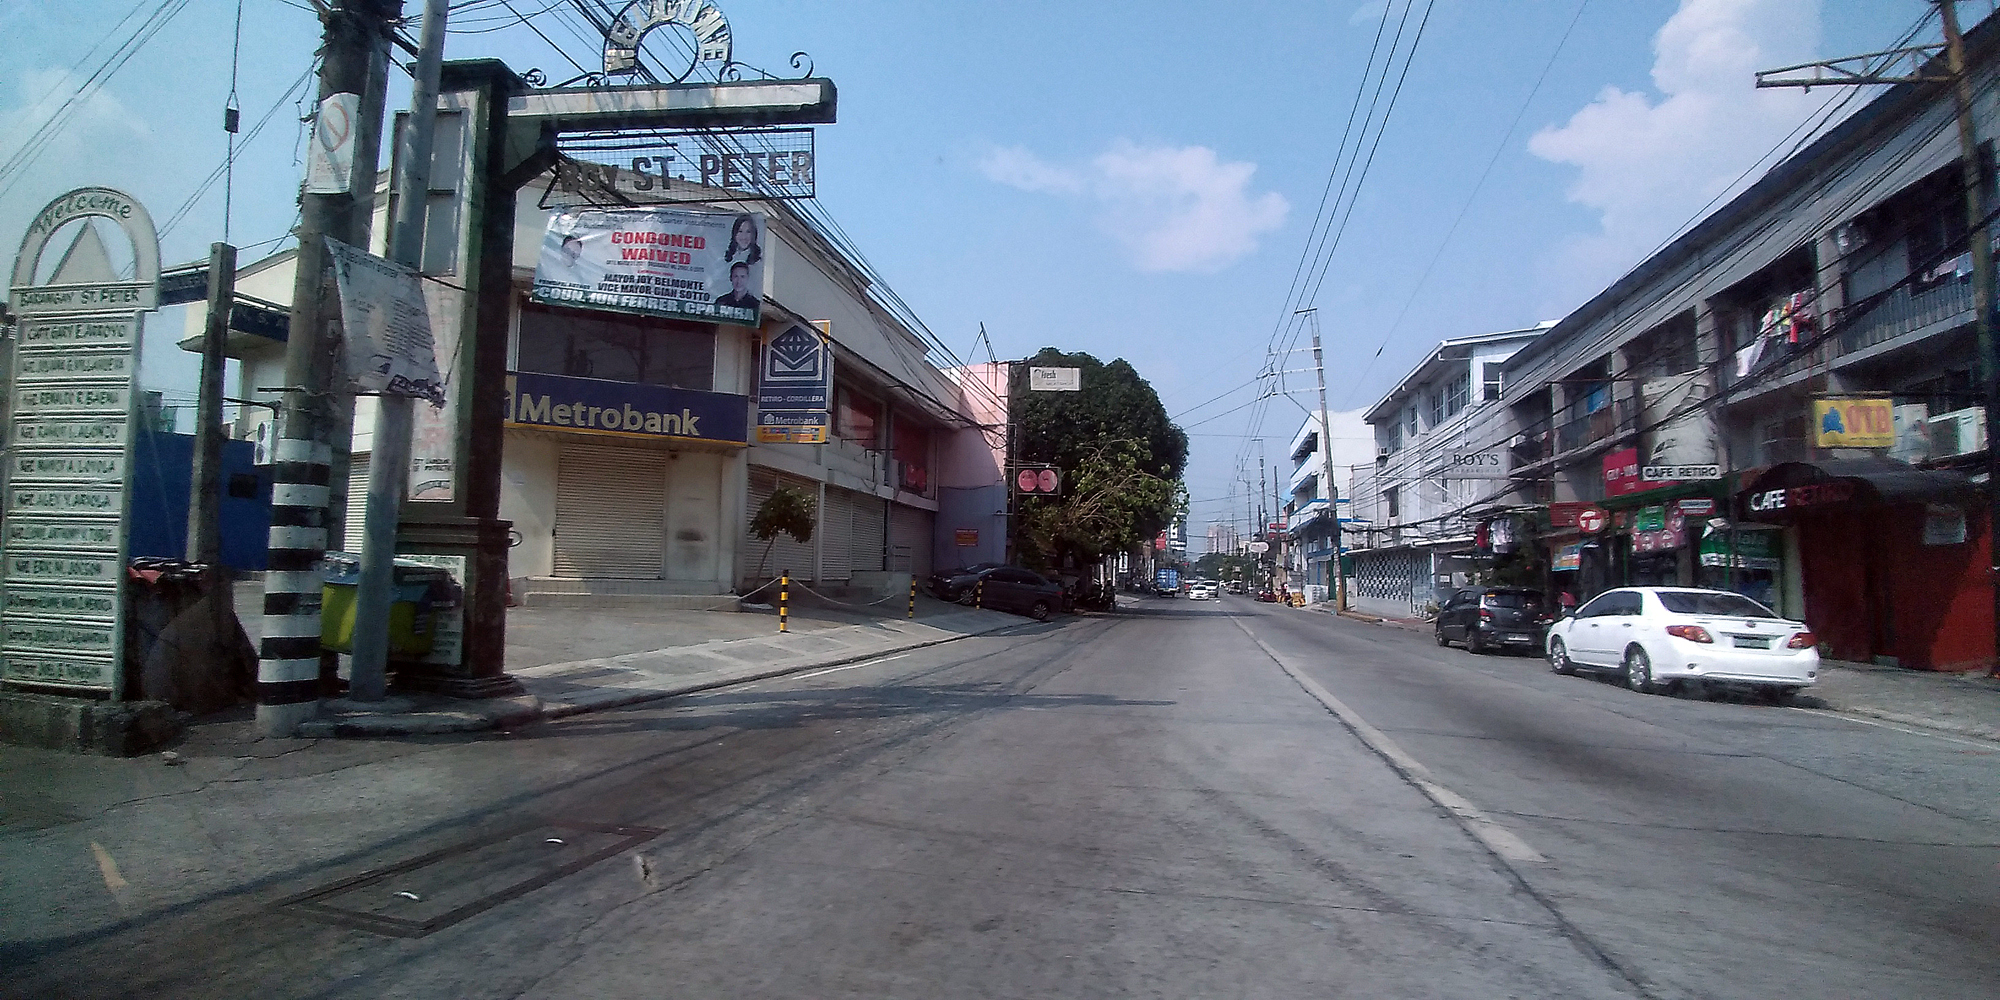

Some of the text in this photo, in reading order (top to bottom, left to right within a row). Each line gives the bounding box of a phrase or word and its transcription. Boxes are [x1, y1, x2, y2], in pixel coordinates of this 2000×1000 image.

[632, 155, 686, 191] ST.
[701, 150, 814, 189] PETER
[35, 192, 133, 235] Welcome
[611, 231, 706, 250] CONDONED
[622, 247, 692, 266] WAIVED
[604, 273, 635, 284] MAYOR
[655, 276, 705, 291] BELMONTE
[100, 287, 140, 304] PETER
[598, 282, 619, 293] VICE
[620, 284, 652, 296] MAYOR
[679, 290, 711, 302] SOTTO
[519, 392, 701, 436] Metrobank
[775, 416, 819, 425] Metrobank
[1452, 453, 1499, 466] ROY'S
[1645, 467, 1673, 478] CAFE
[1679, 466, 1718, 477] RETIRO
[1750, 488, 1787, 512] CAFE
